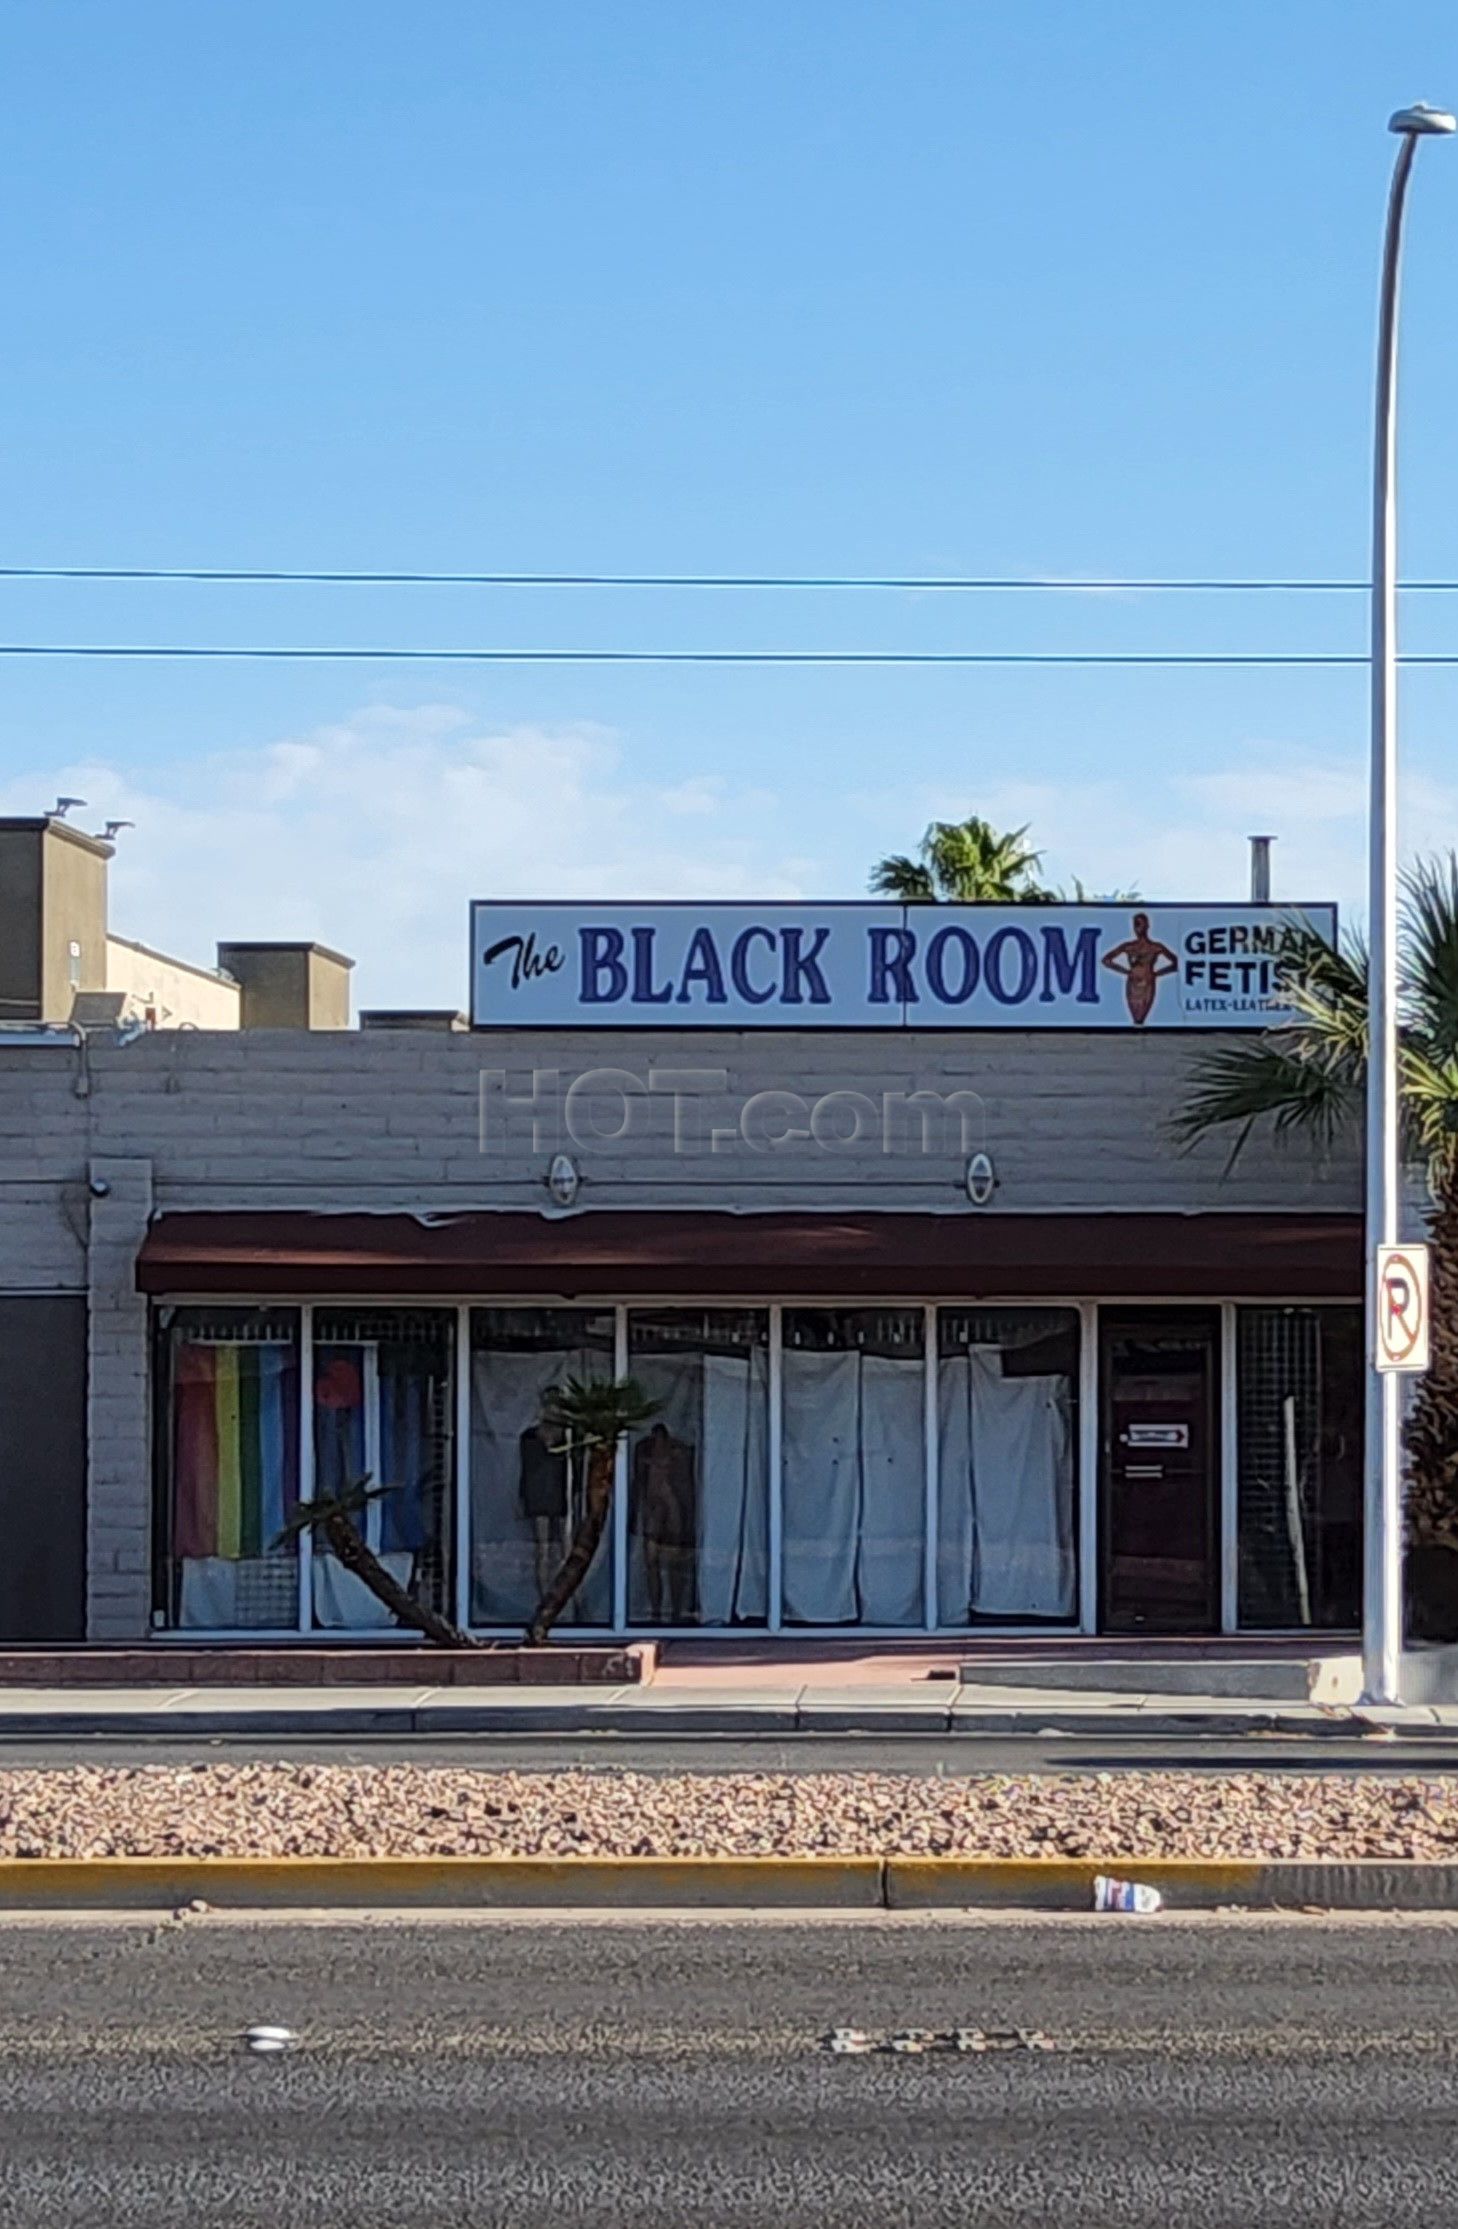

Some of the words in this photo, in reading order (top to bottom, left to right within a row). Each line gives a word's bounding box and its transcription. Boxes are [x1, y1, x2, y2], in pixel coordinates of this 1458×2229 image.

[483, 932, 565, 989] The
[578, 925, 832, 1004] BLACK
[867, 926, 1102, 1005] ROOM
[1185, 960, 1308, 994] FETIS
